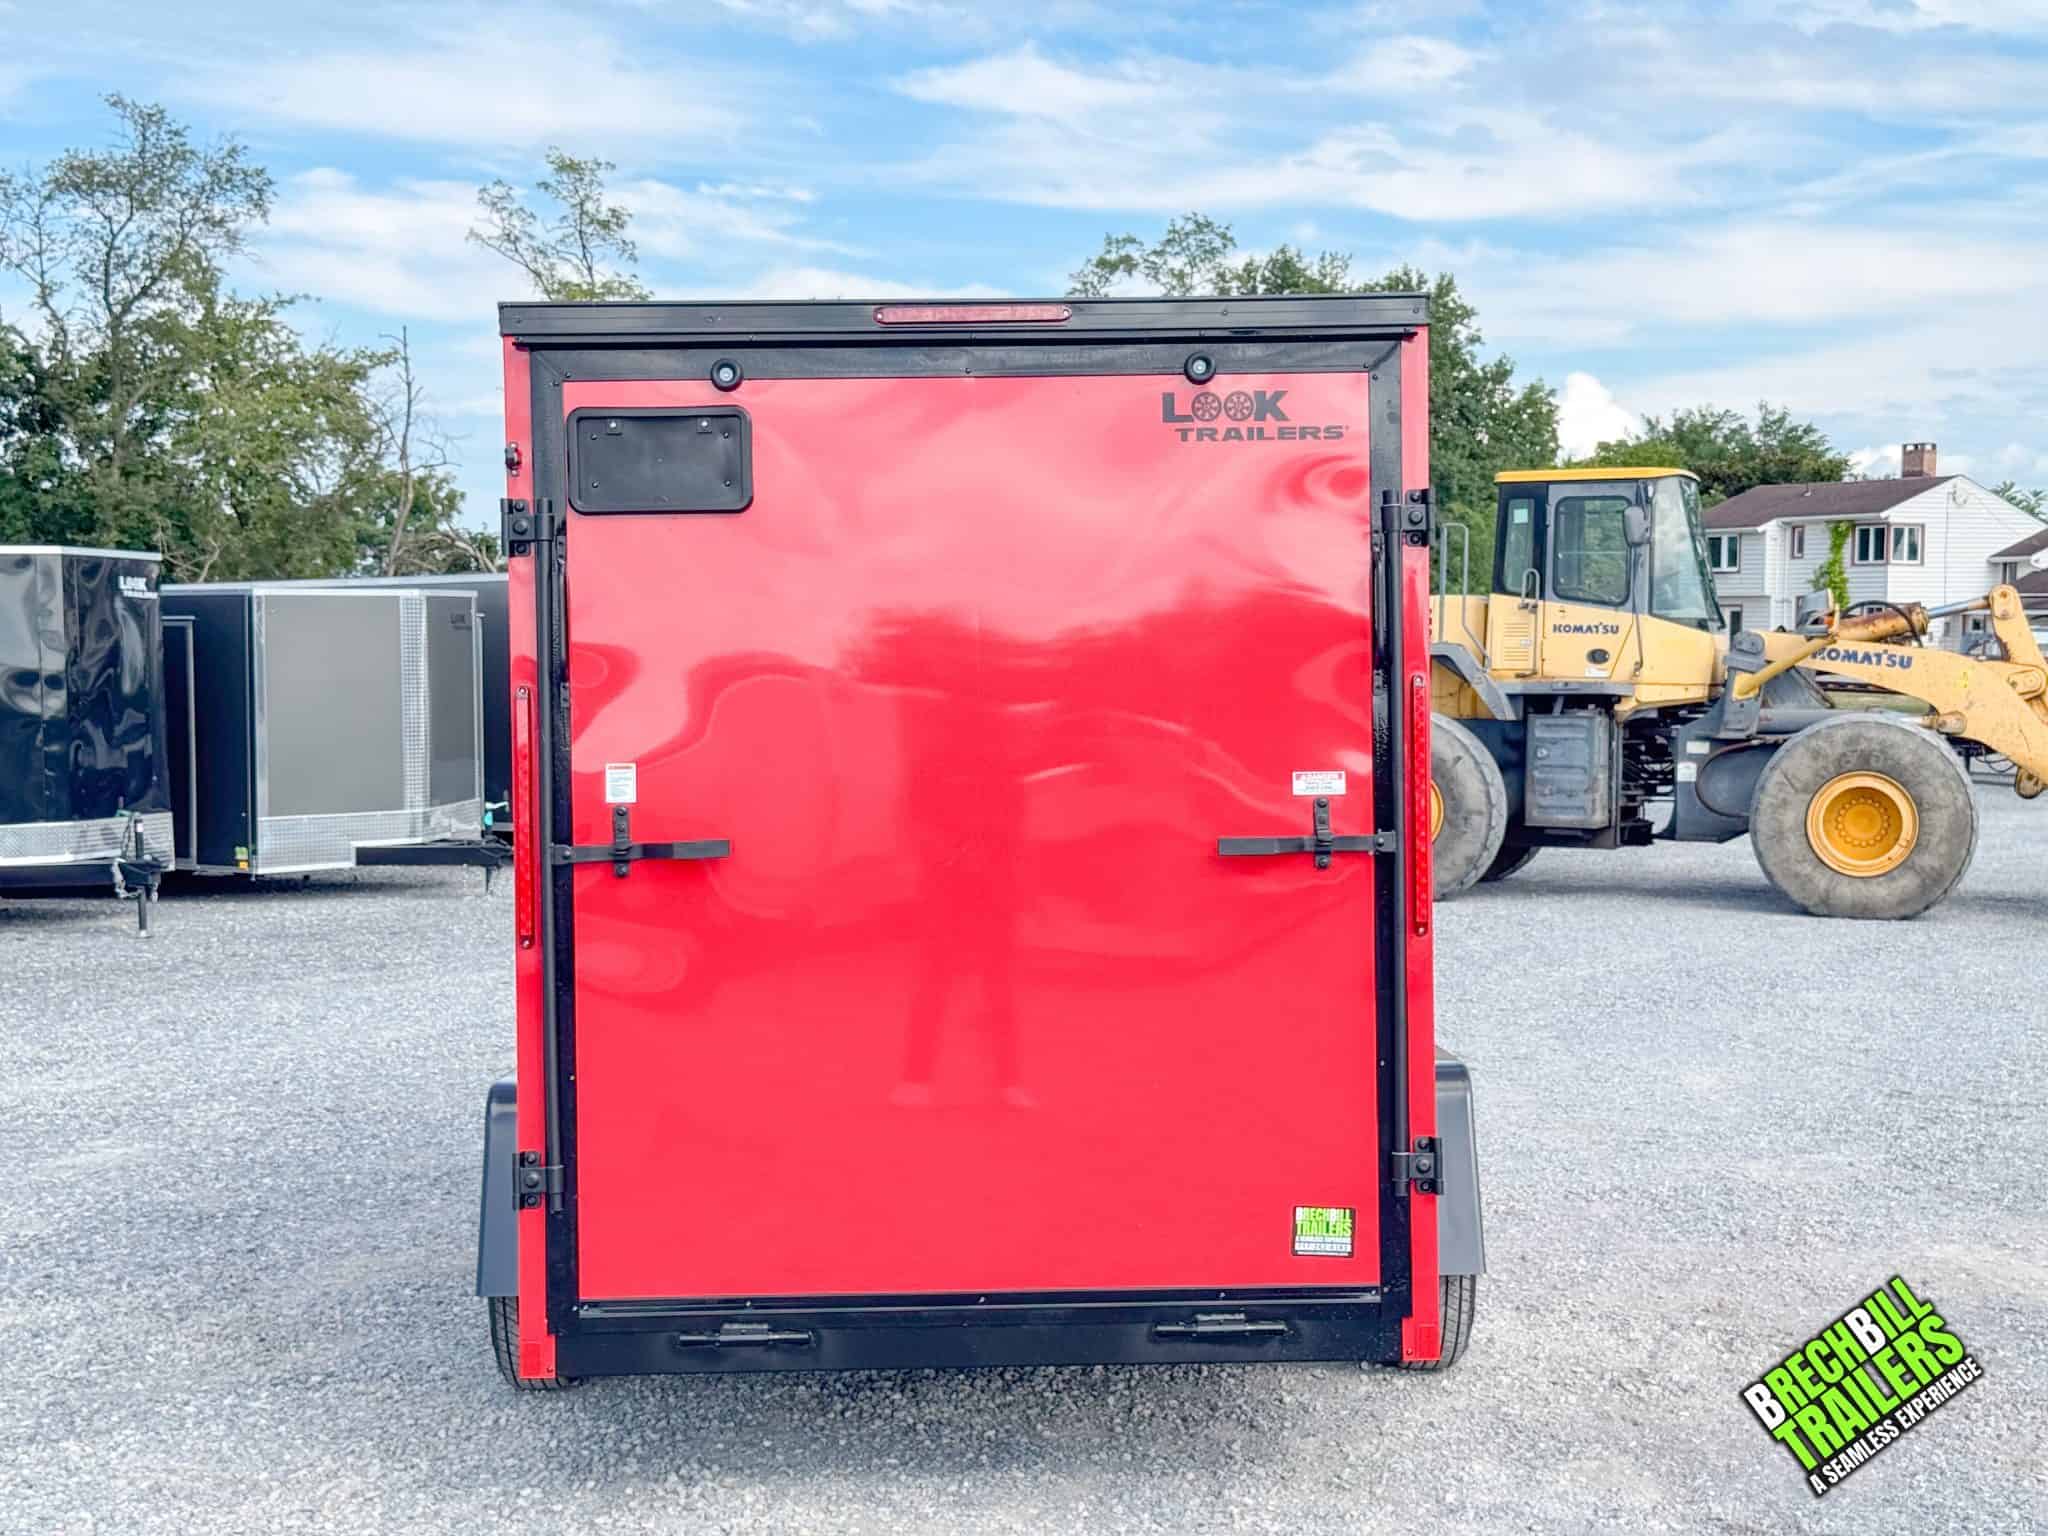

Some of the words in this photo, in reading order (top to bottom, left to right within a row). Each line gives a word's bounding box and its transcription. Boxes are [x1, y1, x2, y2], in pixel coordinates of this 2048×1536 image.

[1162, 390, 1290, 423] LOOK
[1174, 425, 1345, 442] TRAILERS
[1552, 622, 1619, 635] KOMATSU
[1296, 1221, 1352, 1237] TRAILERS
